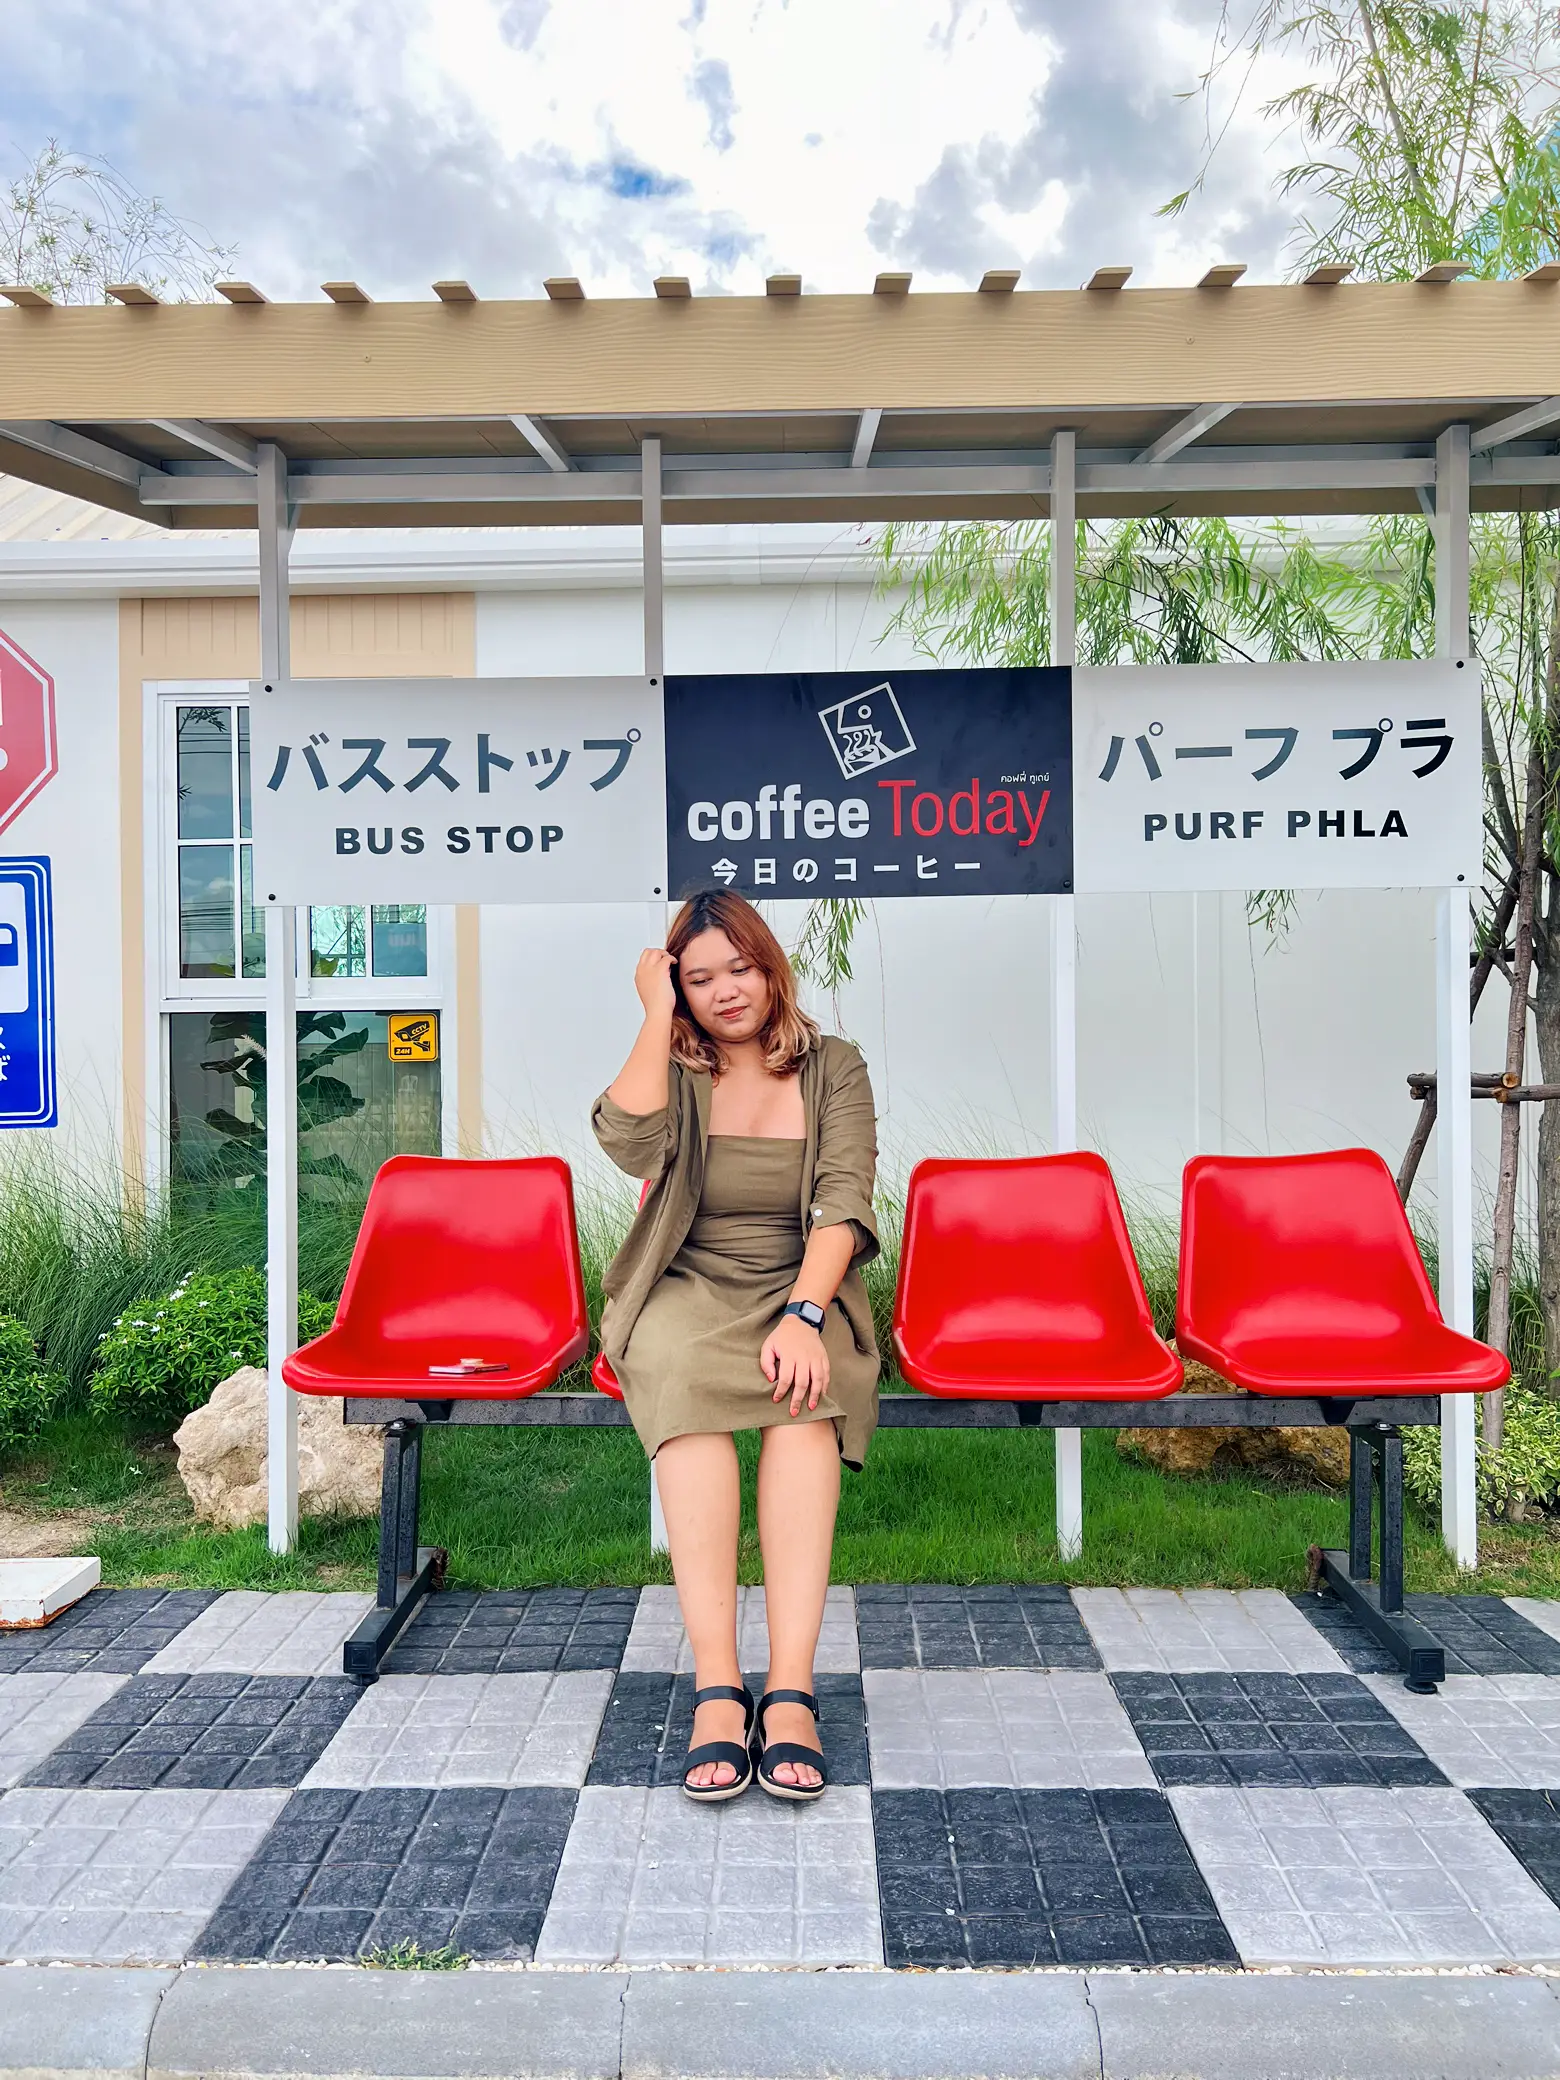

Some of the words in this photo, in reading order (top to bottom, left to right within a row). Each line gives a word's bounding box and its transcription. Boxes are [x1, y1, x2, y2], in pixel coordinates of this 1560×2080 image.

[266, 728, 641, 794] バスストップ
[1099, 722, 1299, 782] パーフ
[1333, 717, 1455, 780] プラ
[687, 784, 870, 842] coffee
[878, 778, 1051, 846] Today
[1144, 810, 1264, 841] PURF
[1288, 809, 1409, 838] PHLA
[336, 827, 425, 855] BUS
[447, 825, 564, 854] STOP
[711, 854, 981, 886] 今日のコーヒー
[411, 1023, 427, 1035] CCTV
